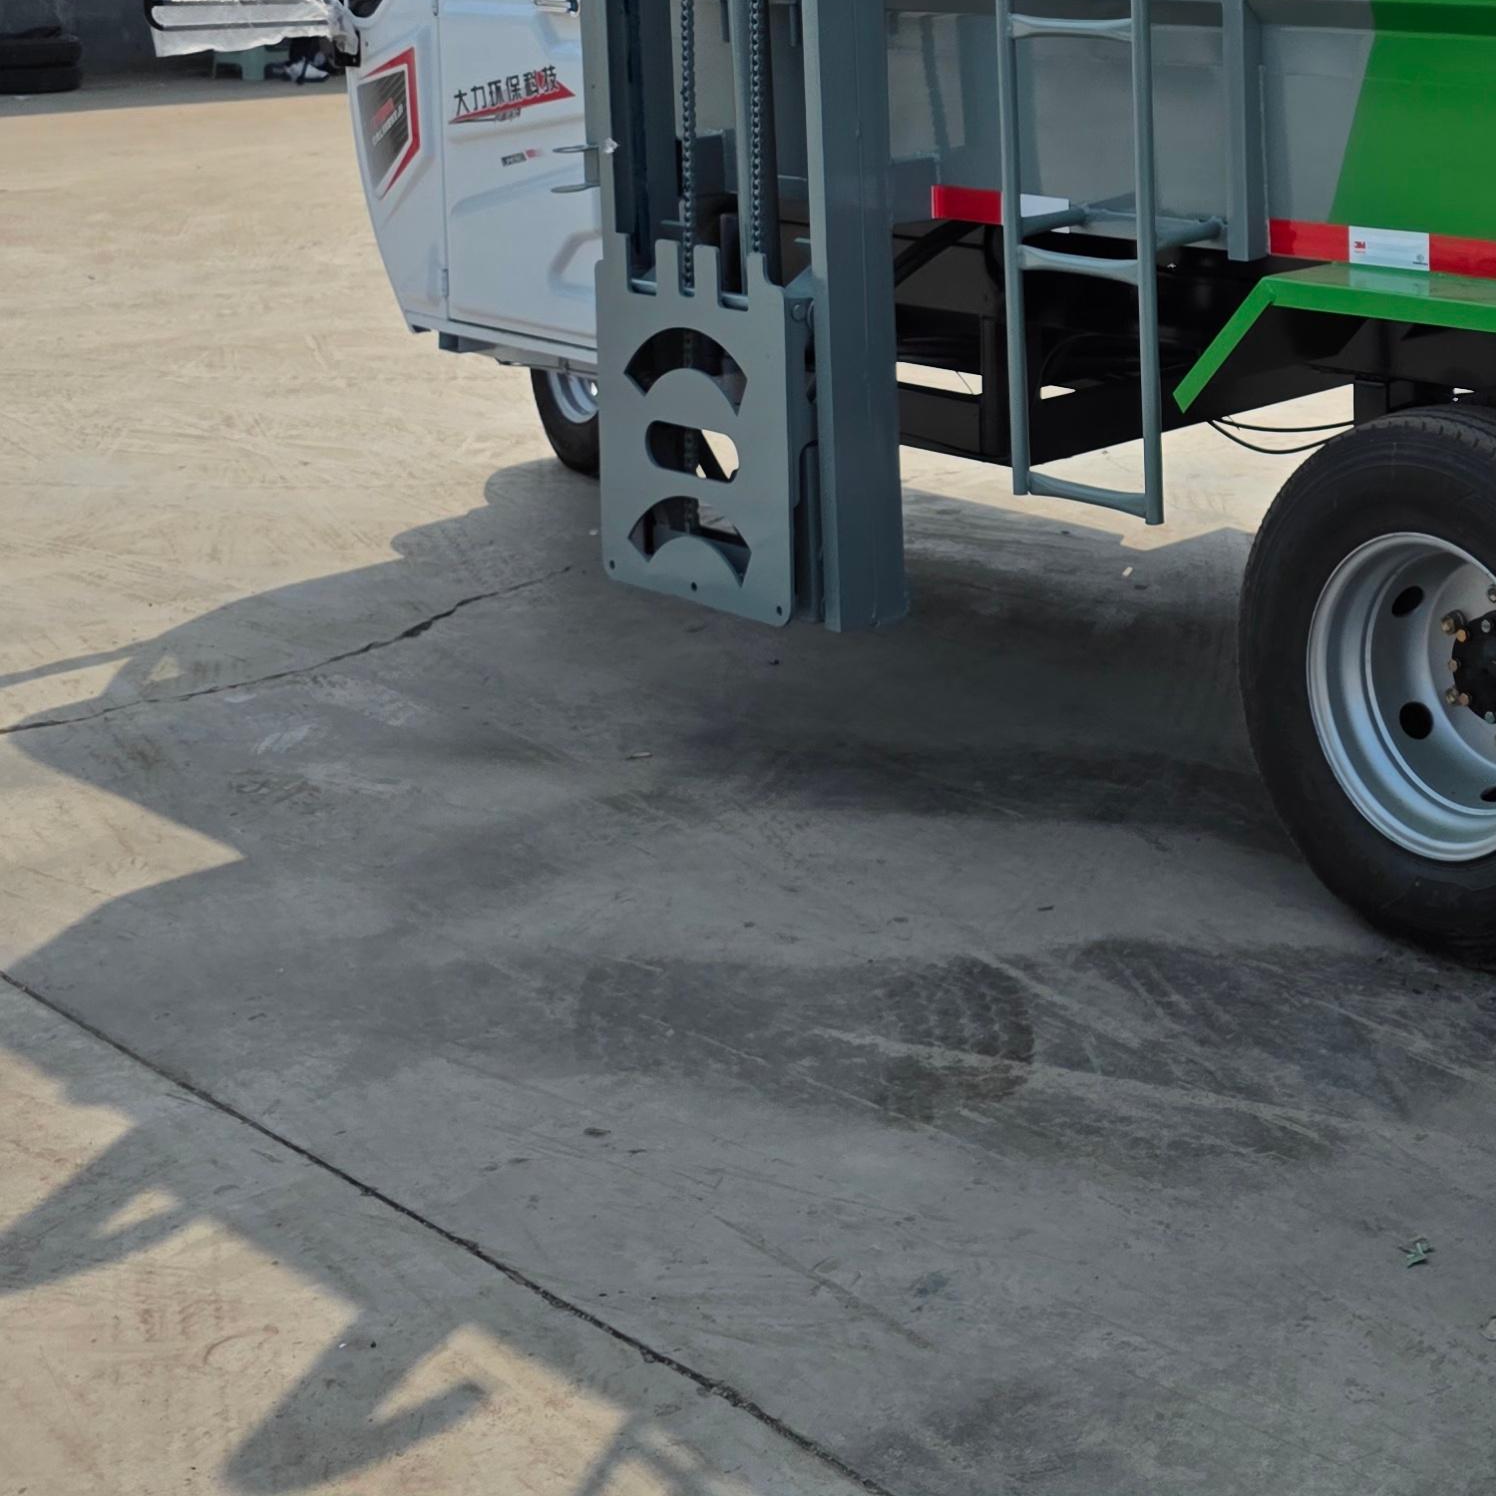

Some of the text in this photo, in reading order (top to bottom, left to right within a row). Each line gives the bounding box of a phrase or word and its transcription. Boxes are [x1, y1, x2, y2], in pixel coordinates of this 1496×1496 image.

[453, 65, 558, 116] 大力环保科技
[1354, 241, 1366, 249] 3M
